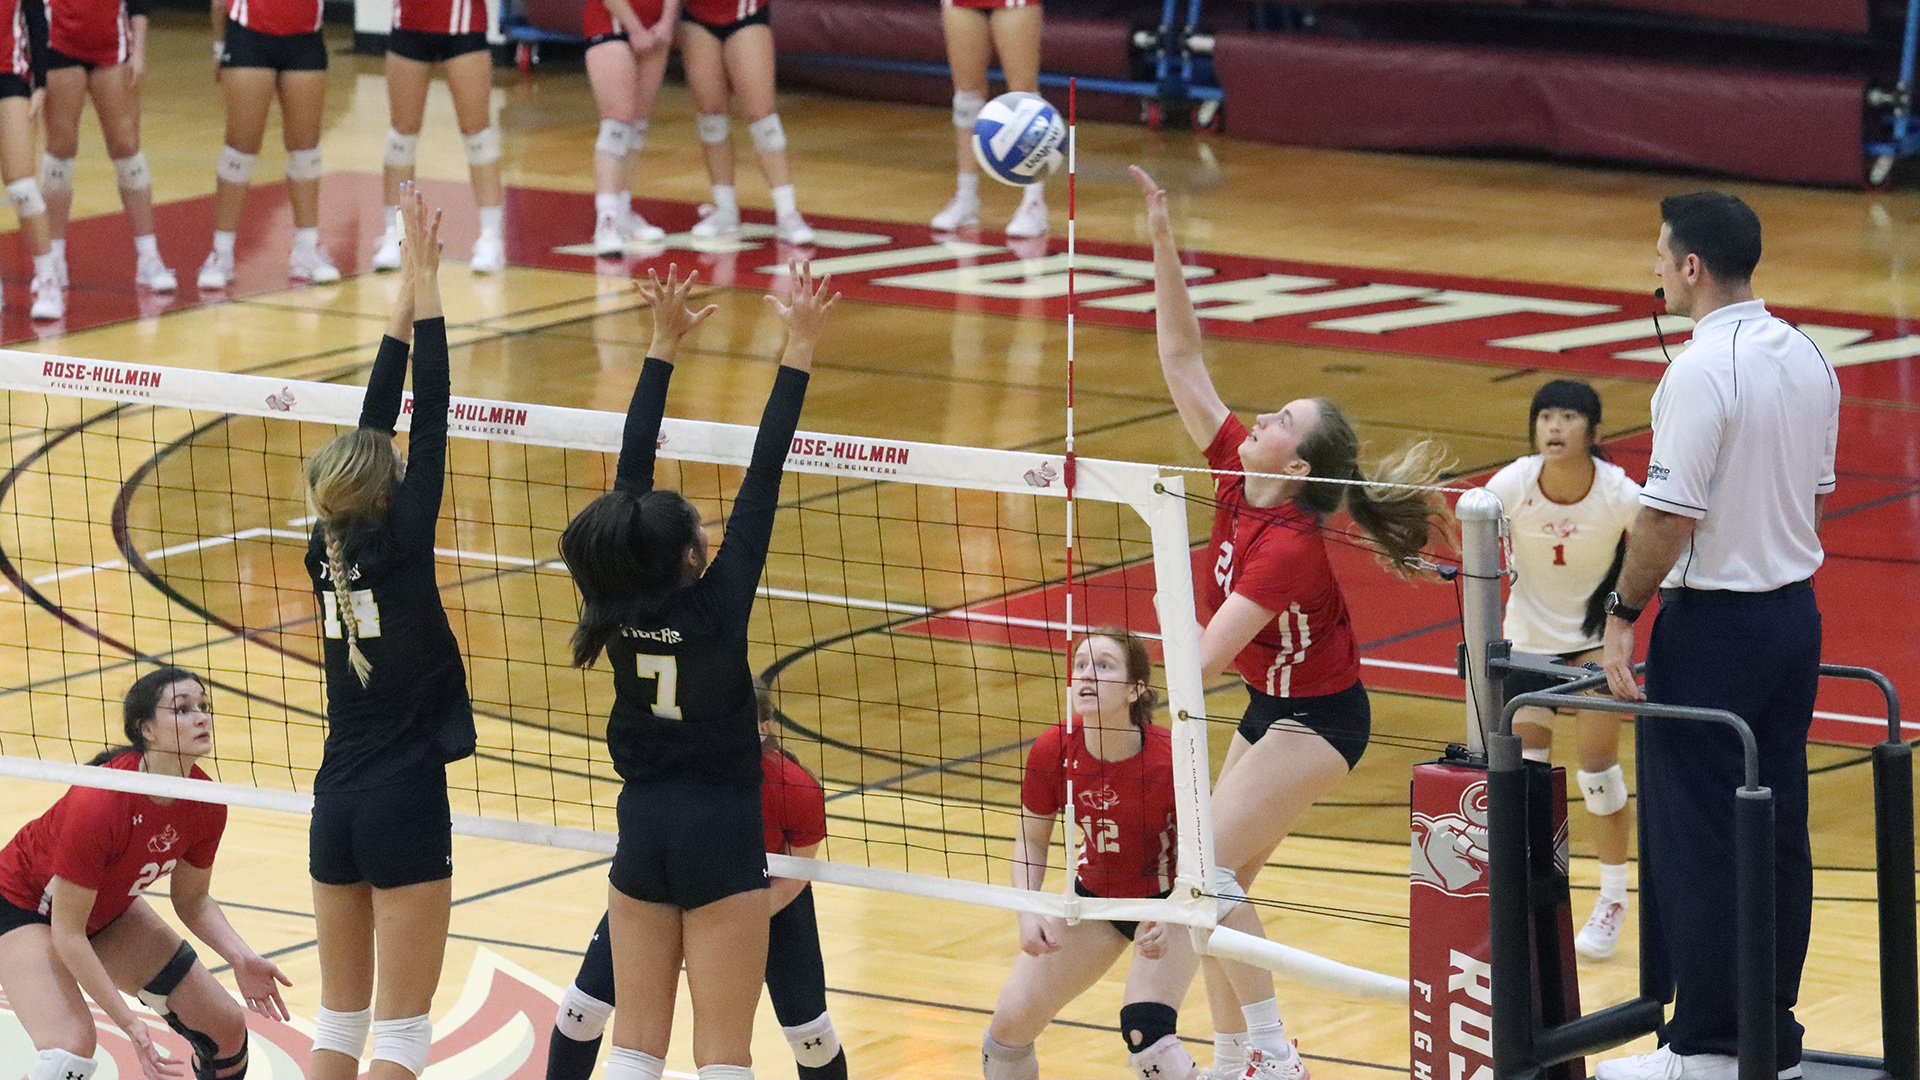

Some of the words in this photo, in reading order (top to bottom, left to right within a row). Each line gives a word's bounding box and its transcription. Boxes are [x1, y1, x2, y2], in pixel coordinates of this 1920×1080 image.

[43, 361, 162, 388] ROSE-HULMAN
[96, 386, 150, 397] ENGINEERS
[402, 398, 528, 426] R-HULMAN
[458, 424, 516, 436] ENGINEERS
[837, 463, 897, 475] ENGINEERS
[1553, 544, 1567, 566] 1
[322, 589, 381, 639] 14
[636, 653, 683, 721] 7
[1080, 815, 1120, 853] 12
